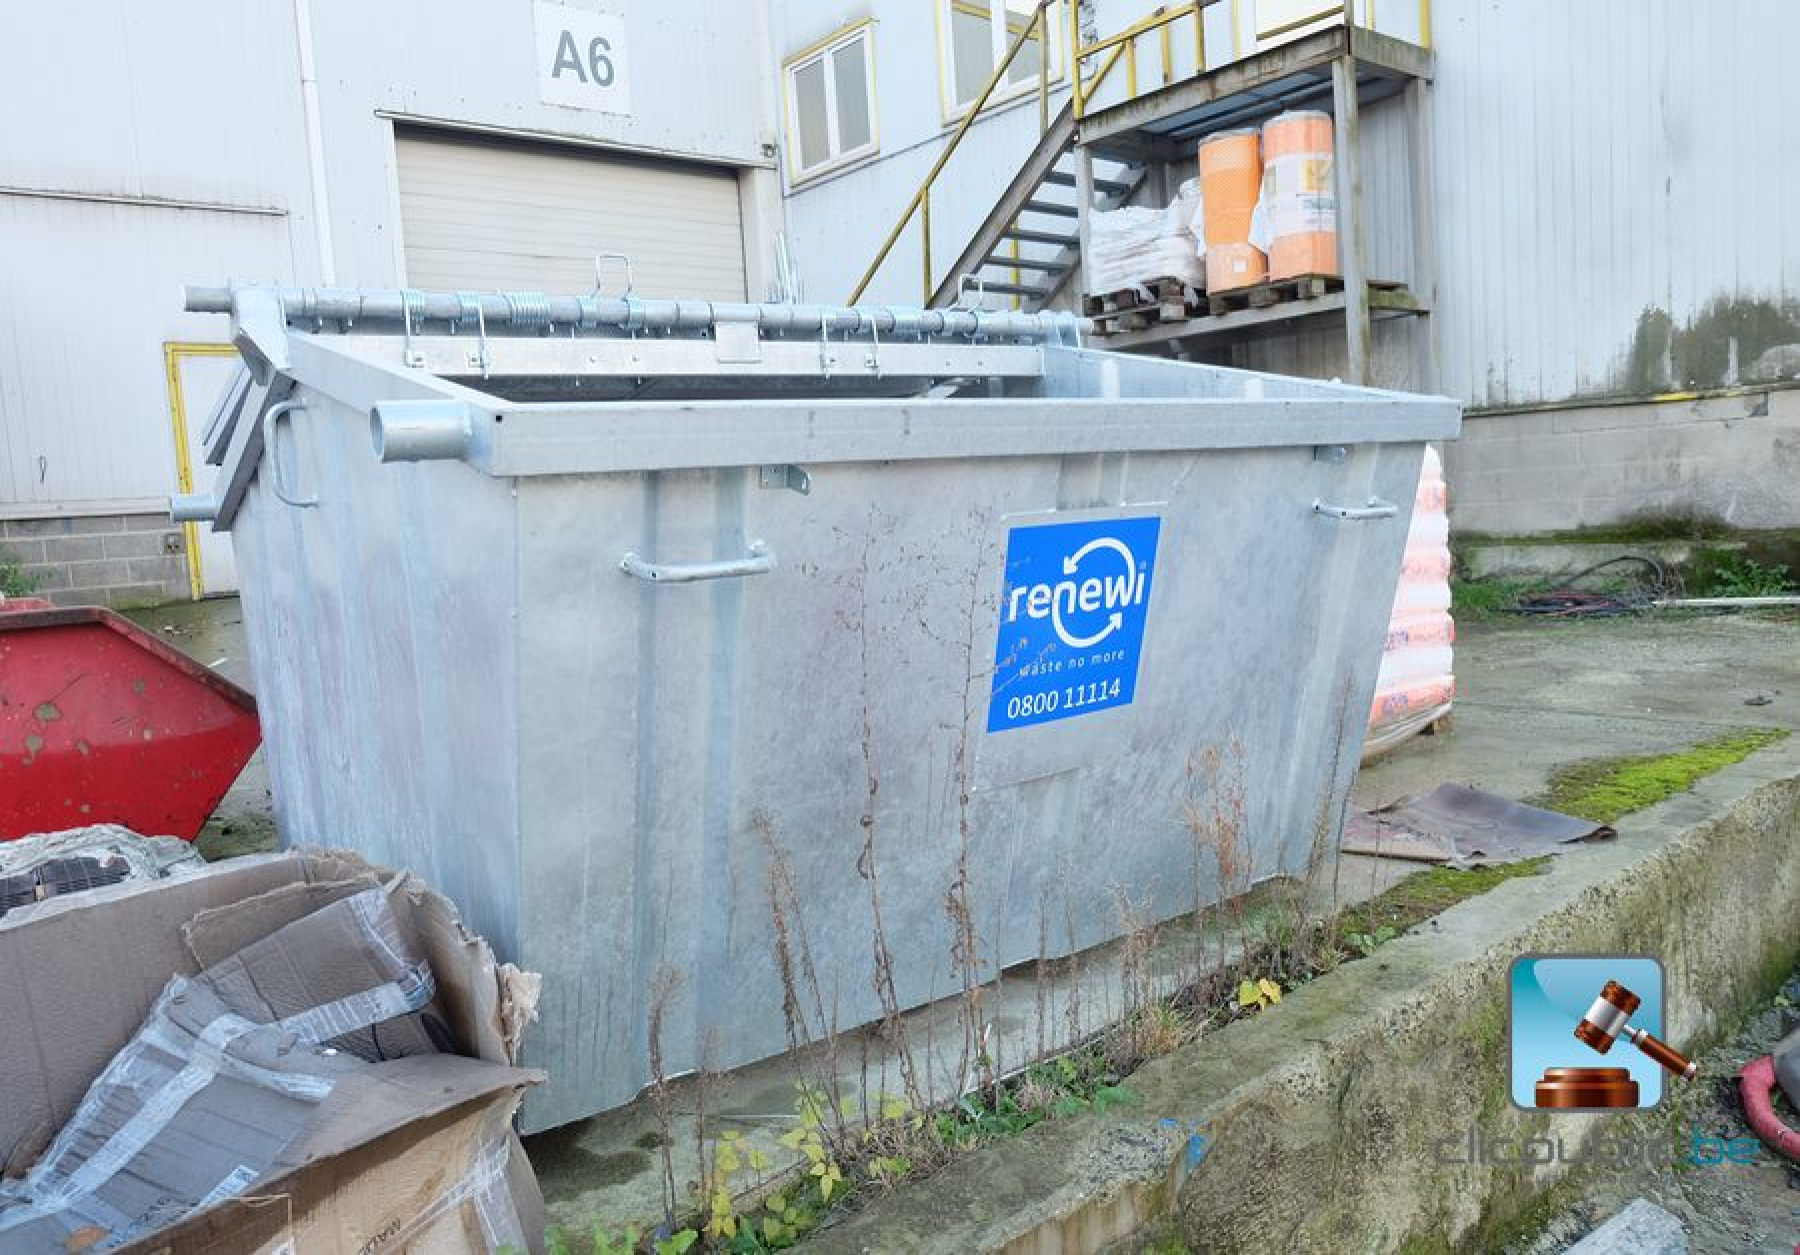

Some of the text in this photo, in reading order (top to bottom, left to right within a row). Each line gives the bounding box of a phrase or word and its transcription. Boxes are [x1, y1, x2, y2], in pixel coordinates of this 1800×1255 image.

[551, 29, 615, 87] A6
[1009, 560, 1148, 622] renewi
[1020, 649, 1125, 678] waste no more
[1007, 677, 1121, 720] 0800 11114
